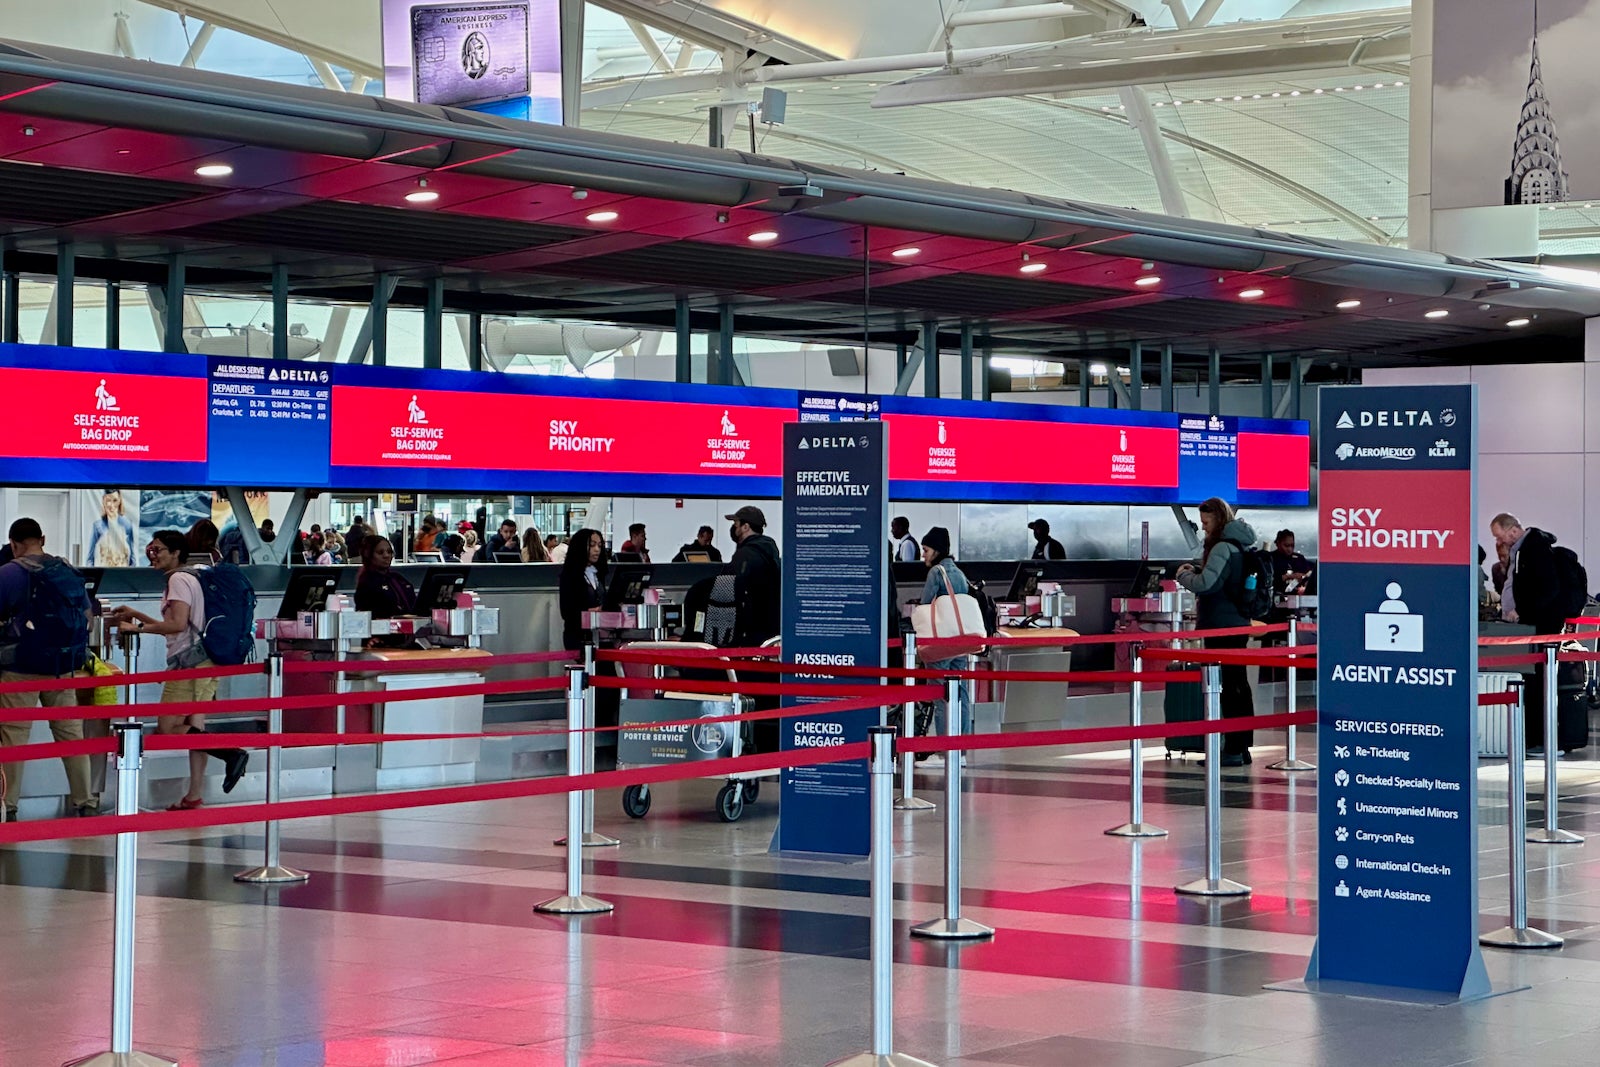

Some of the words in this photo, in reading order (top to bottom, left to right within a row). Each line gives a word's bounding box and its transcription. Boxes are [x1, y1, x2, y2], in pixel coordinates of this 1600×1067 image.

[441, 15, 477, 24] AMERICAN
[478, 13, 508, 22] EXPRESS
[457, 22, 493, 30] BUSINESS
[229, 366, 246, 374] DESKS
[247, 366, 264, 374] SERVE
[281, 369, 318, 382] DELTA
[212, 384, 255, 394] DEPARTURES
[74, 414, 140, 428] SELF-SERVICE
[1360, 410, 1434, 426] DELTA
[390, 427, 444, 439] SELF-SERVICE
[550, 420, 578, 435] SKY
[81, 428, 102, 440] BAG
[104, 429, 132, 441] DROP
[396, 440, 414, 450] BAG
[414, 440, 438, 451] DROP
[549, 436, 613, 452] PRIORITY
[707, 438, 751, 450] SELF-SERVICE
[812, 437, 856, 448] DELTA
[712, 450, 726, 460] BAG
[727, 451, 746, 461] DROP
[928, 447, 956, 457] OVERSIZE
[1428, 448, 1456, 457] KLM
[928, 457, 956, 467] BAGGAGE
[796, 471, 850, 483] EFFECTIVE
[796, 484, 870, 496] IMMEDIATELY
[1331, 508, 1382, 527] SKY
[1331, 528, 1450, 548] PRIORITY
[794, 653, 855, 666] PASSENGER
[1332, 664, 1392, 683] AGENT
[1395, 667, 1456, 686] ASSIST
[794, 722, 843, 734] CHECKED
[1335, 720, 1388, 734] SERVICES
[1390, 722, 1444, 737] OFFERED:
[624, 732, 651, 741] PORTER
[652, 733, 684, 742] SERVICE
[794, 734, 845, 748] BAGGAGE
[1355, 746, 1410, 761] Re-Ticketing
[1355, 774, 1393, 787] Checked
[1394, 776, 1434, 791] Specialty
[1434, 778, 1460, 791] Items
[1355, 802, 1426, 817] Unaccompanied
[1427, 807, 1459, 820] Minors
[1355, 830, 1394, 844] Carry-on
[1395, 832, 1414, 844] Pets
[1356, 858, 1410, 872] International
[1411, 862, 1451, 876] Check-In
[1356, 886, 1382, 898] Agent
[1384, 888, 1431, 902] Assistance
